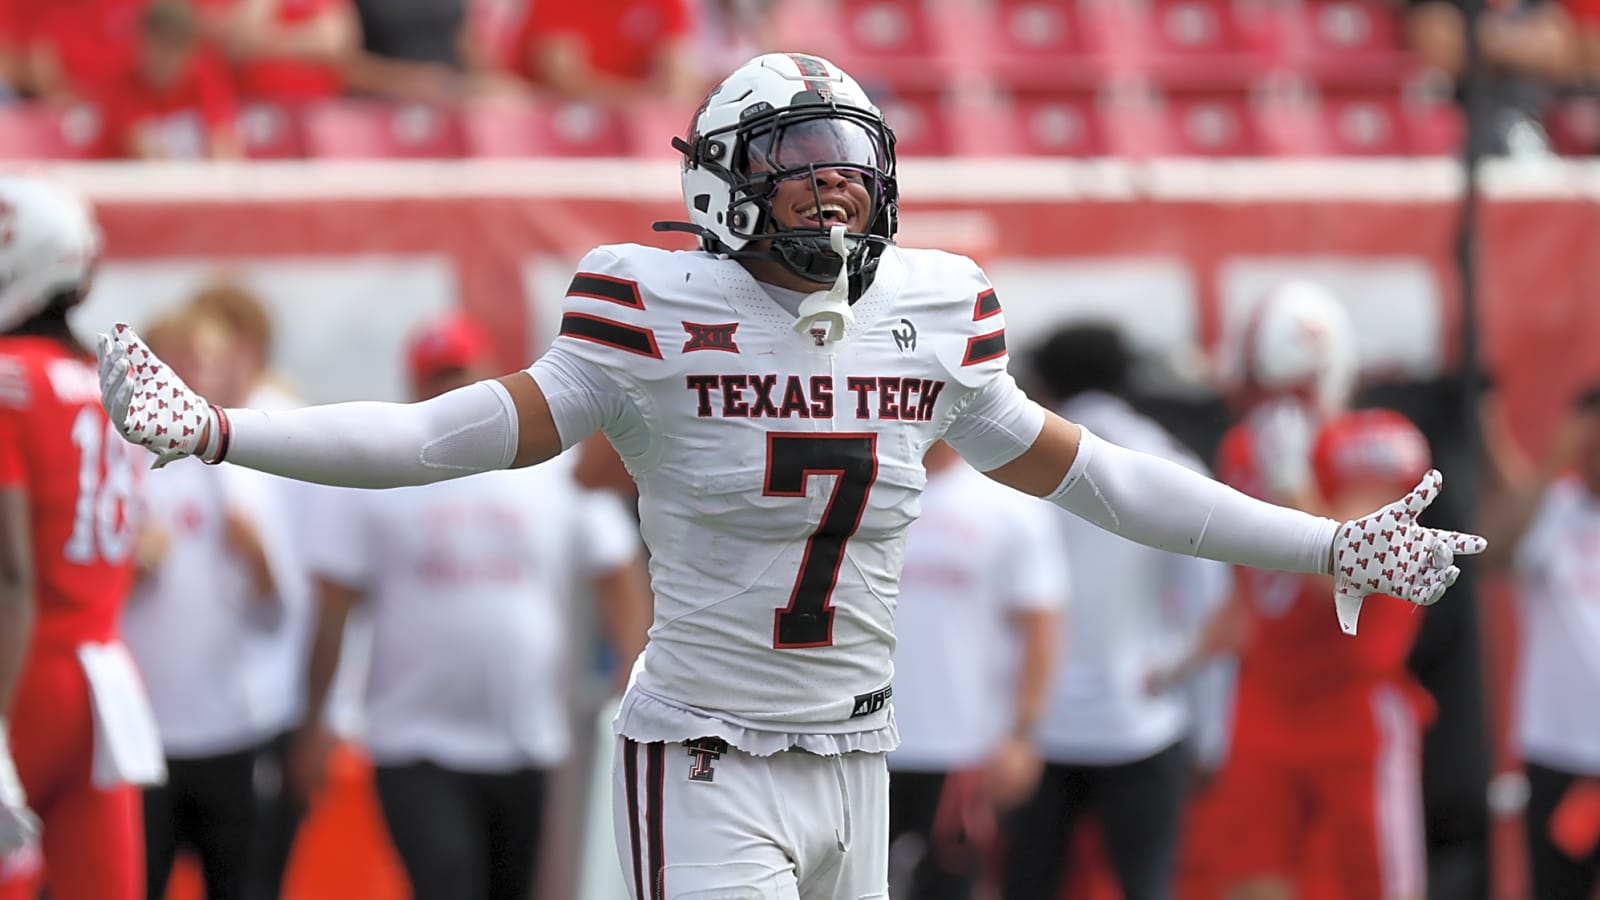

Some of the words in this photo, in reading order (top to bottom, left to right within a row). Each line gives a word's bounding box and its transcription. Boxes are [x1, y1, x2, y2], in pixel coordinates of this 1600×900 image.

[686, 374, 834, 420] TEXAS
[847, 376, 946, 422] TECH
[762, 431, 879, 649] 7
